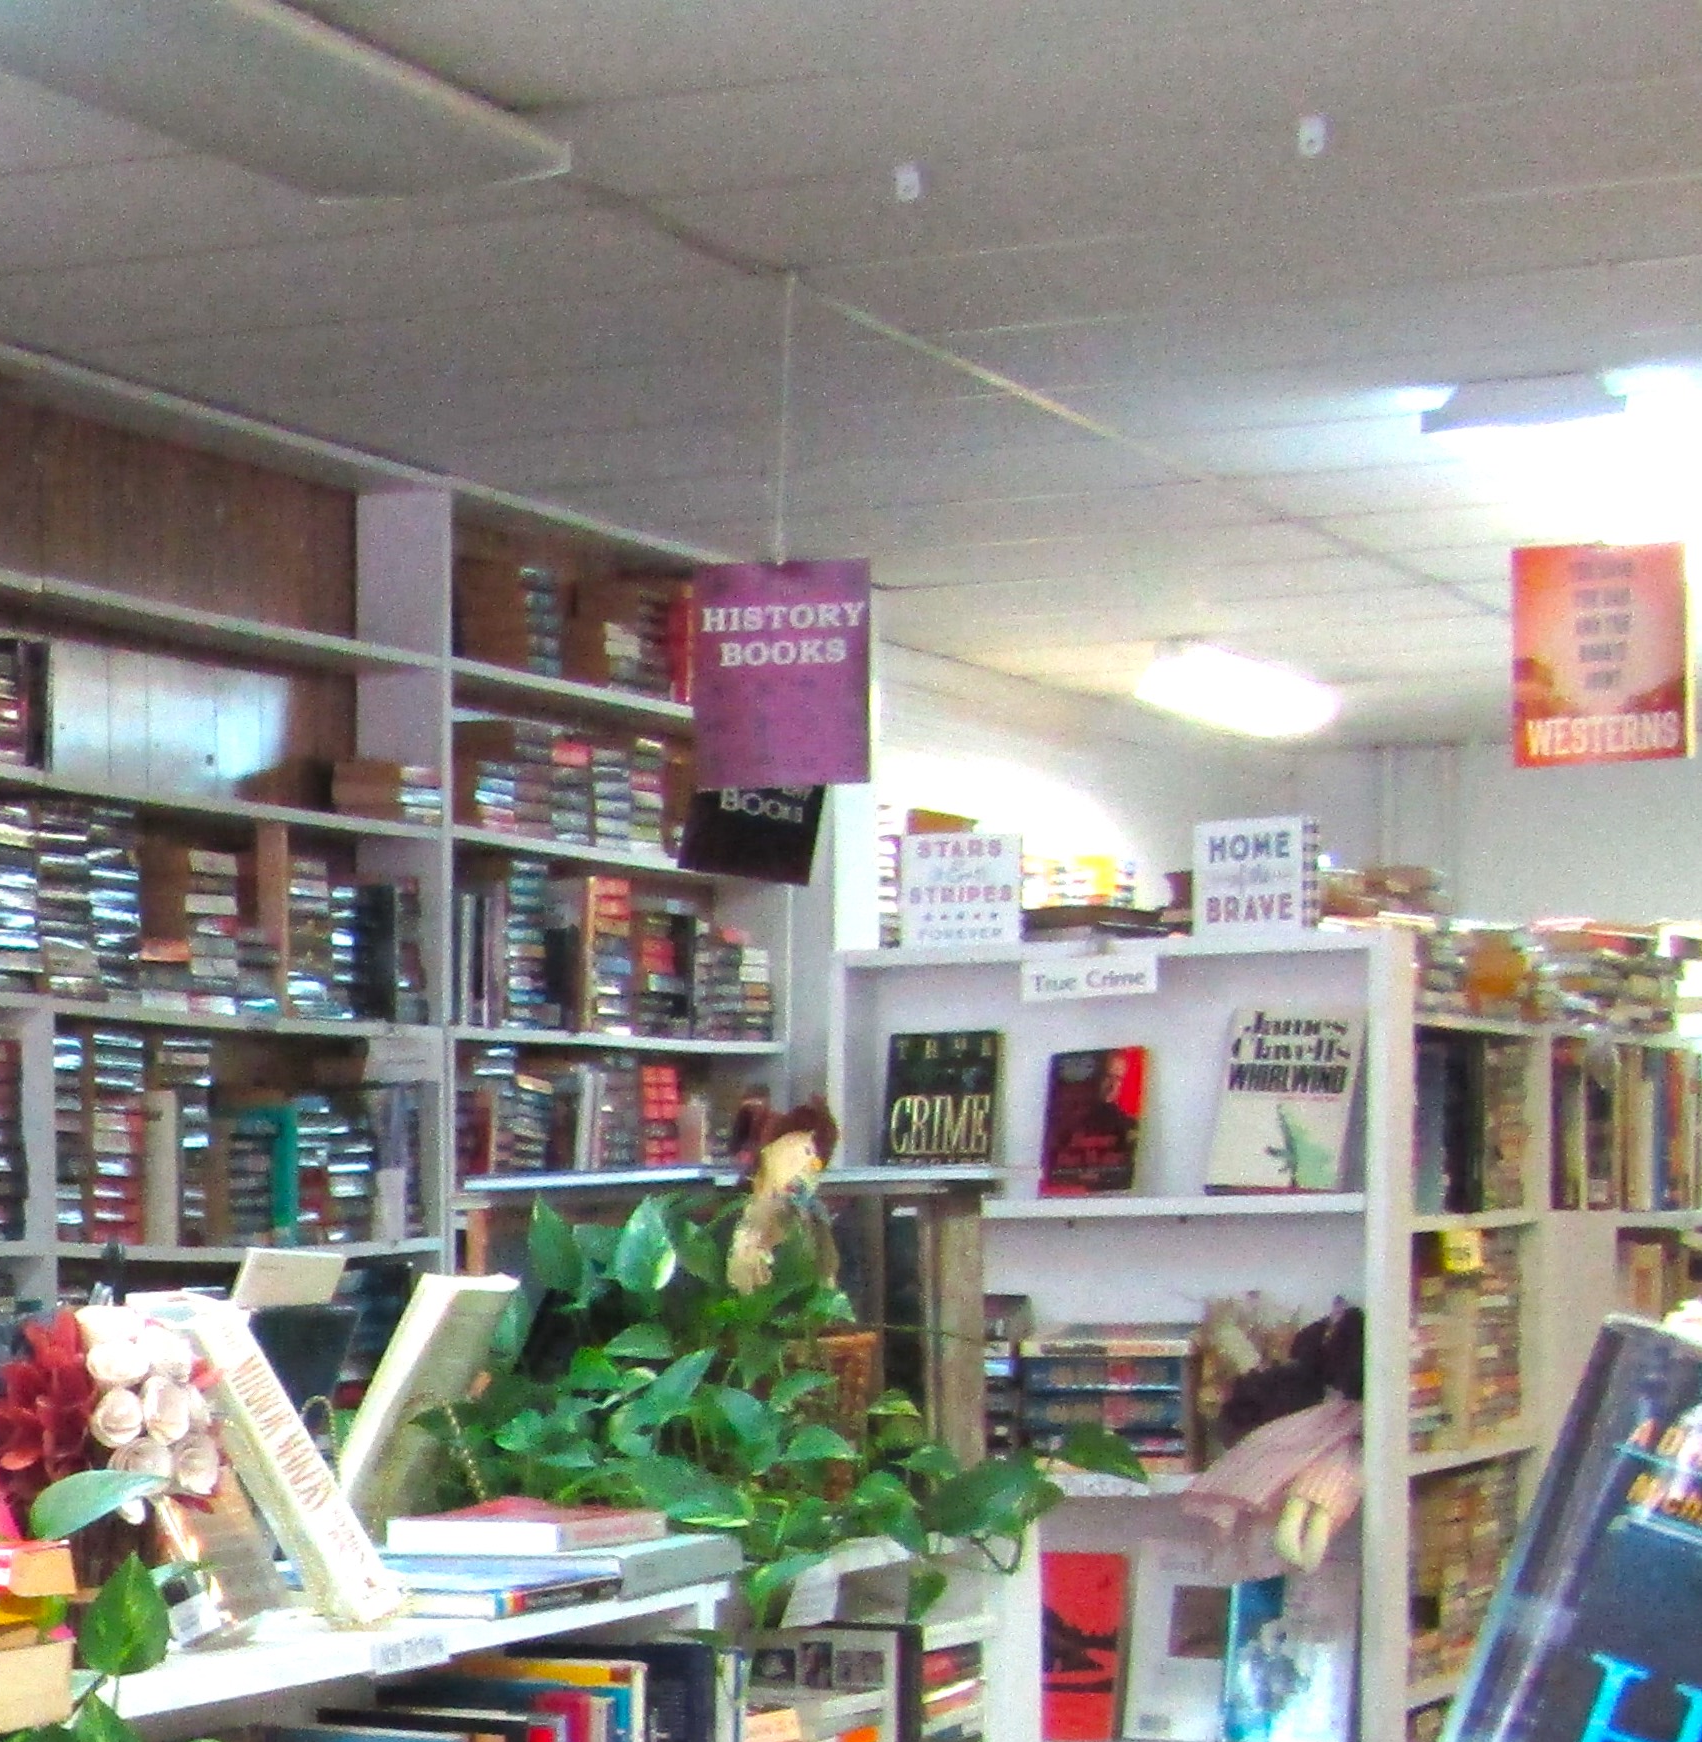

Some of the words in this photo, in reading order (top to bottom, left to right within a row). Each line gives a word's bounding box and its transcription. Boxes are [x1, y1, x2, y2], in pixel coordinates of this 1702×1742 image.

[702, 601, 866, 633] HISTORY
[719, 637, 847, 667] BOOKS
[917, 838, 1004, 859] STARS
[1208, 831, 1291, 864] HOME
[908, 883, 1013, 905] STRIPES
[1204, 891, 1296, 924] BRAVE
[1033, 973, 1077, 993] True
[1084, 967, 1147, 988] Crime
[890, 1094, 991, 1155] CRIME
